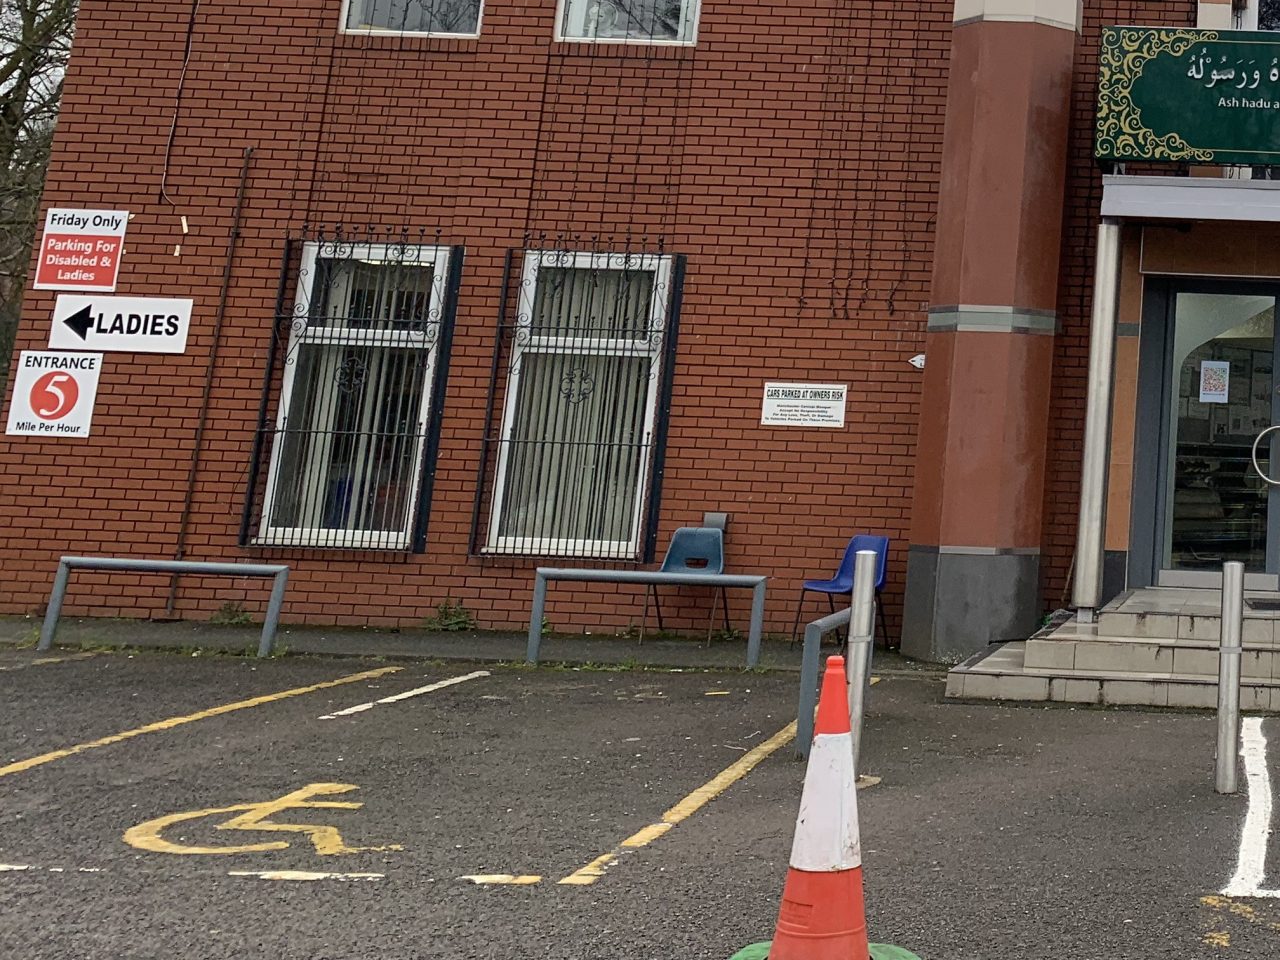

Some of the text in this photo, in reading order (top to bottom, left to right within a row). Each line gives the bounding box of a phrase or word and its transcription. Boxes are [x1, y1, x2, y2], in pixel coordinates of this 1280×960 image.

[1218, 97, 1239, 108] Ash
[1242, 98, 1270, 109] hadu
[50, 213, 122, 230] Friday Only
[47, 239, 116, 254] Parking For
[45, 254, 112, 267] Disabled &
[57, 269, 96, 281] Ladies
[95, 313, 180, 336] LADIES
[25, 355, 96, 370] ENTRANCE
[39, 375, 70, 416] 5
[766, 389, 844, 400] CARS PARKED AT OWNERS RISK
[15, 422, 81, 433] Mile Per Hour
